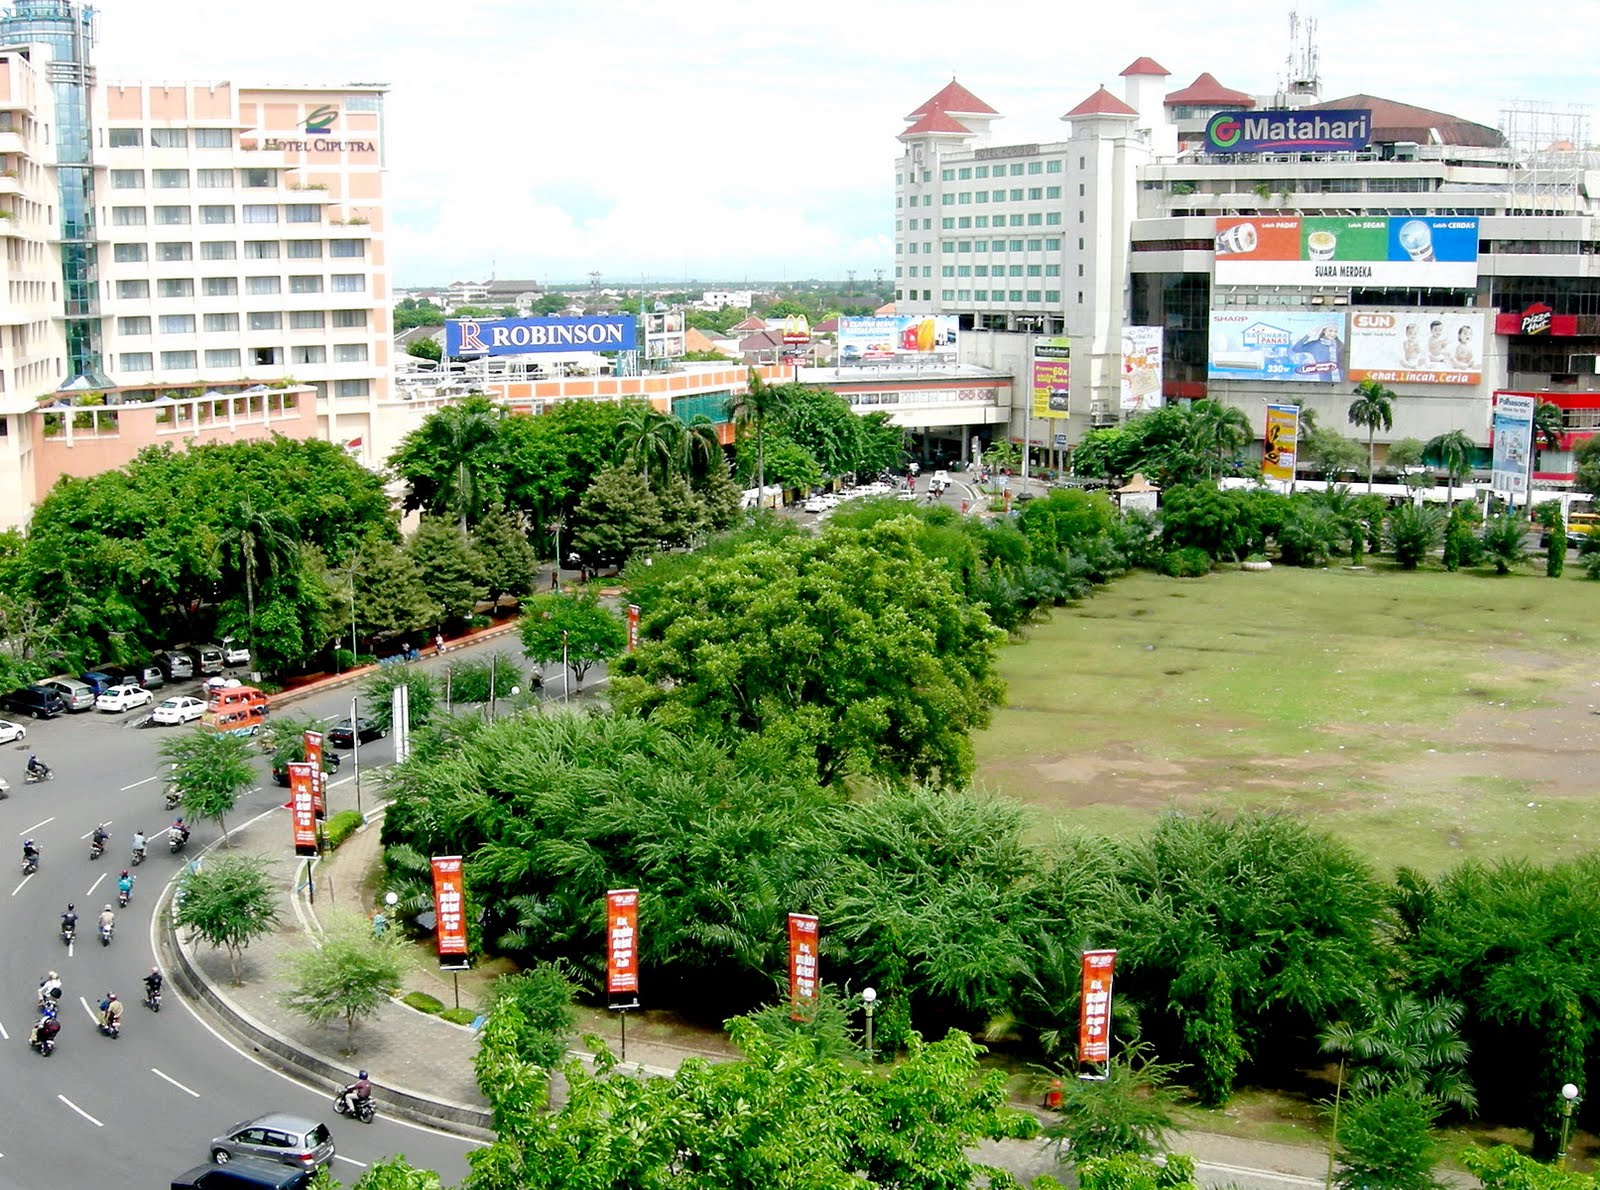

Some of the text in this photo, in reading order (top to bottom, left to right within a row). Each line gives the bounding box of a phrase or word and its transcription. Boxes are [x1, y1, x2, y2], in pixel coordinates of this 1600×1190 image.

[1244, 115, 1366, 141] Matahari
[264, 138, 375, 152] HOTEL CIPUTRA
[1315, 265, 1372, 277] SUARA MERDEKA
[1358, 315, 1390, 327] SUN
[1521, 312, 1551, 331] Pizza
[1526, 320, 1549, 333] Hut
[459, 322, 624, 354] R ROBINSON
[1440, 373, 1468, 383] Ceria
[1499, 397, 1531, 408] Panasonic
